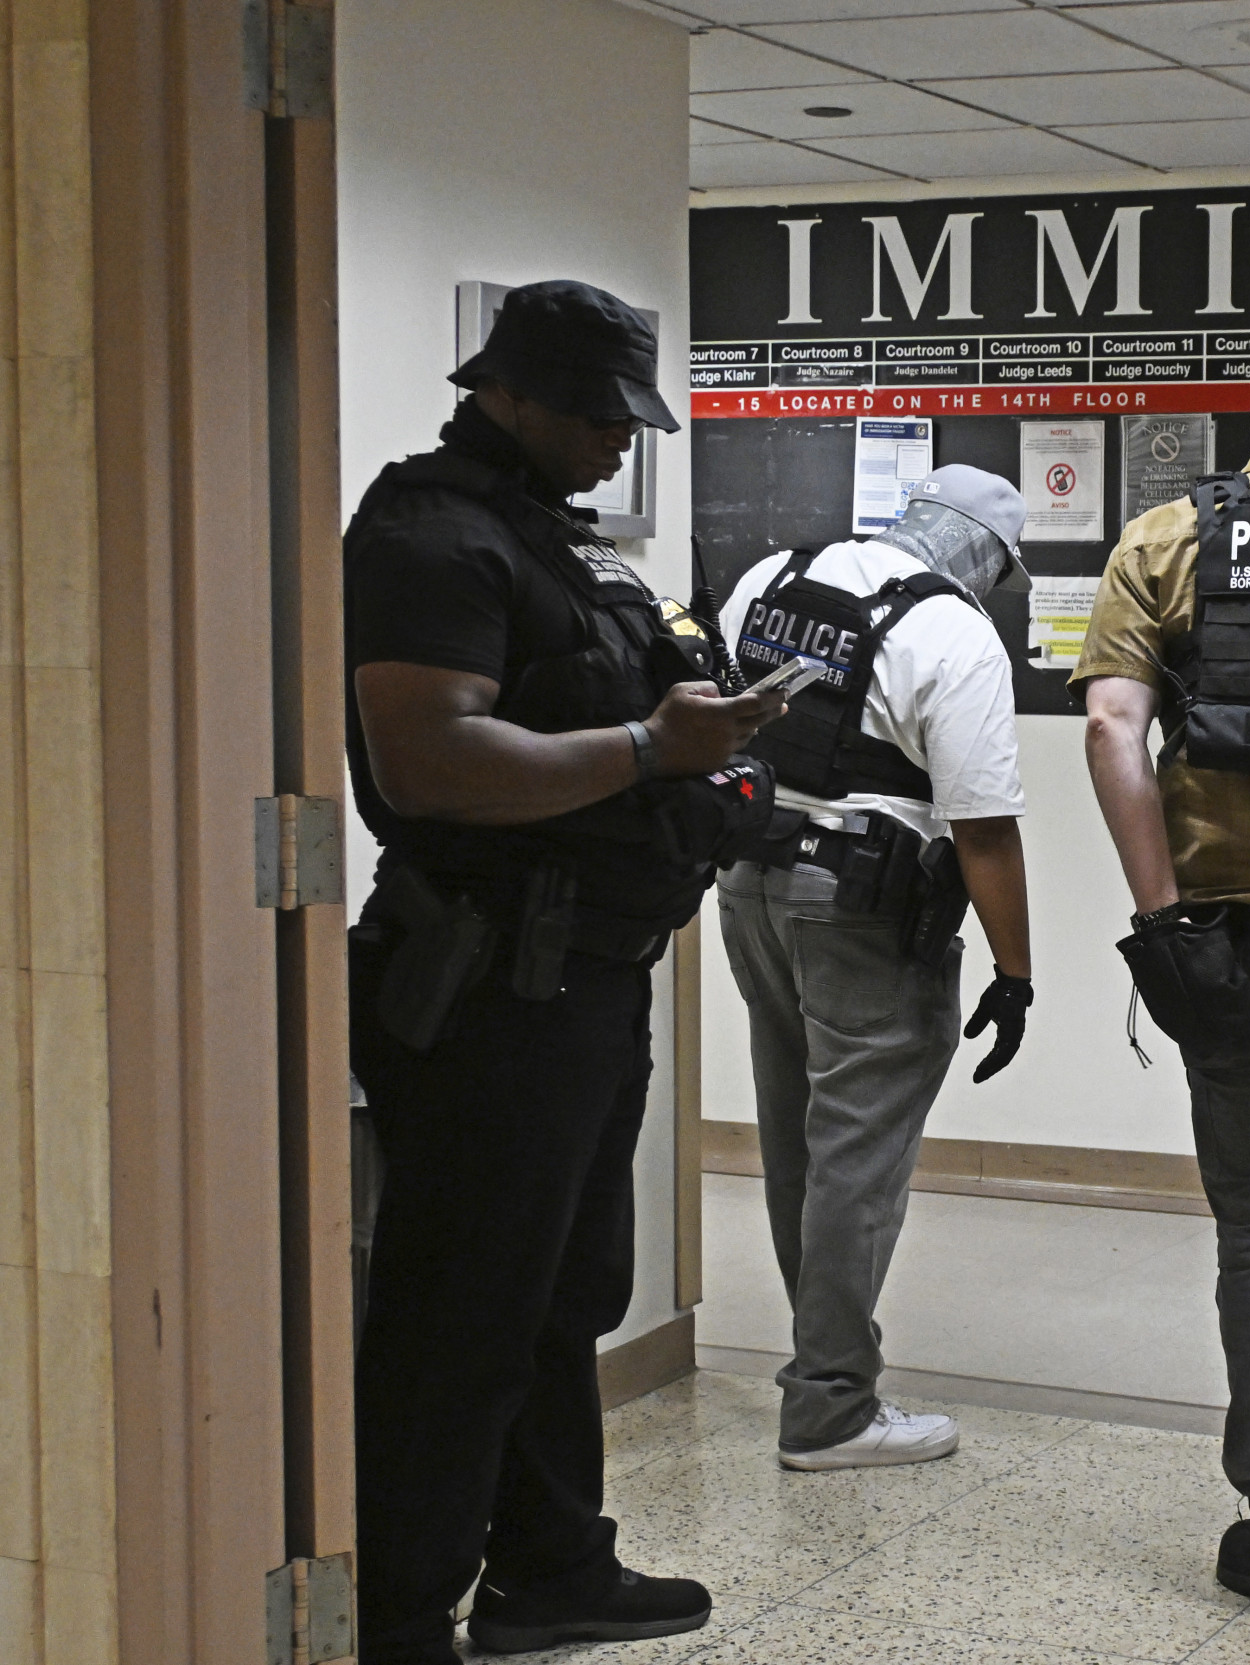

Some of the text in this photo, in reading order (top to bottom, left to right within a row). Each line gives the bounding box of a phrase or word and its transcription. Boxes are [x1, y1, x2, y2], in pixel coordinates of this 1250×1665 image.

[781, 345, 863, 360] Courtroom 8
[886, 343, 969, 358] Courtroom 9
[990, 340, 1082, 355] Courtroom 10
[1102, 338, 1194, 353] Courtroom 11
[690, 347, 759, 361] ourtroom 7
[691, 369, 756, 385] udge Klahr
[796, 367, 854, 377] Judge Nazaire
[894, 365, 958, 376] Judge Dandelet
[999, 364, 1072, 380] Judge Leeds
[1105, 363, 1191, 379] Judge Douchy
[738, 397, 761, 411] 15
[779, 395, 874, 410] LOCATED
[893, 395, 921, 409] ON
[939, 394, 982, 408] THE
[1000, 393, 1050, 407] 14TH
[1073, 392, 1147, 407] FLOOR
[1142, 421, 1189, 435] NOTICE
[1158, 464, 1185, 472] EATING
[746, 603, 858, 665] POLICE
[740, 640, 789, 667] FEDERAL
